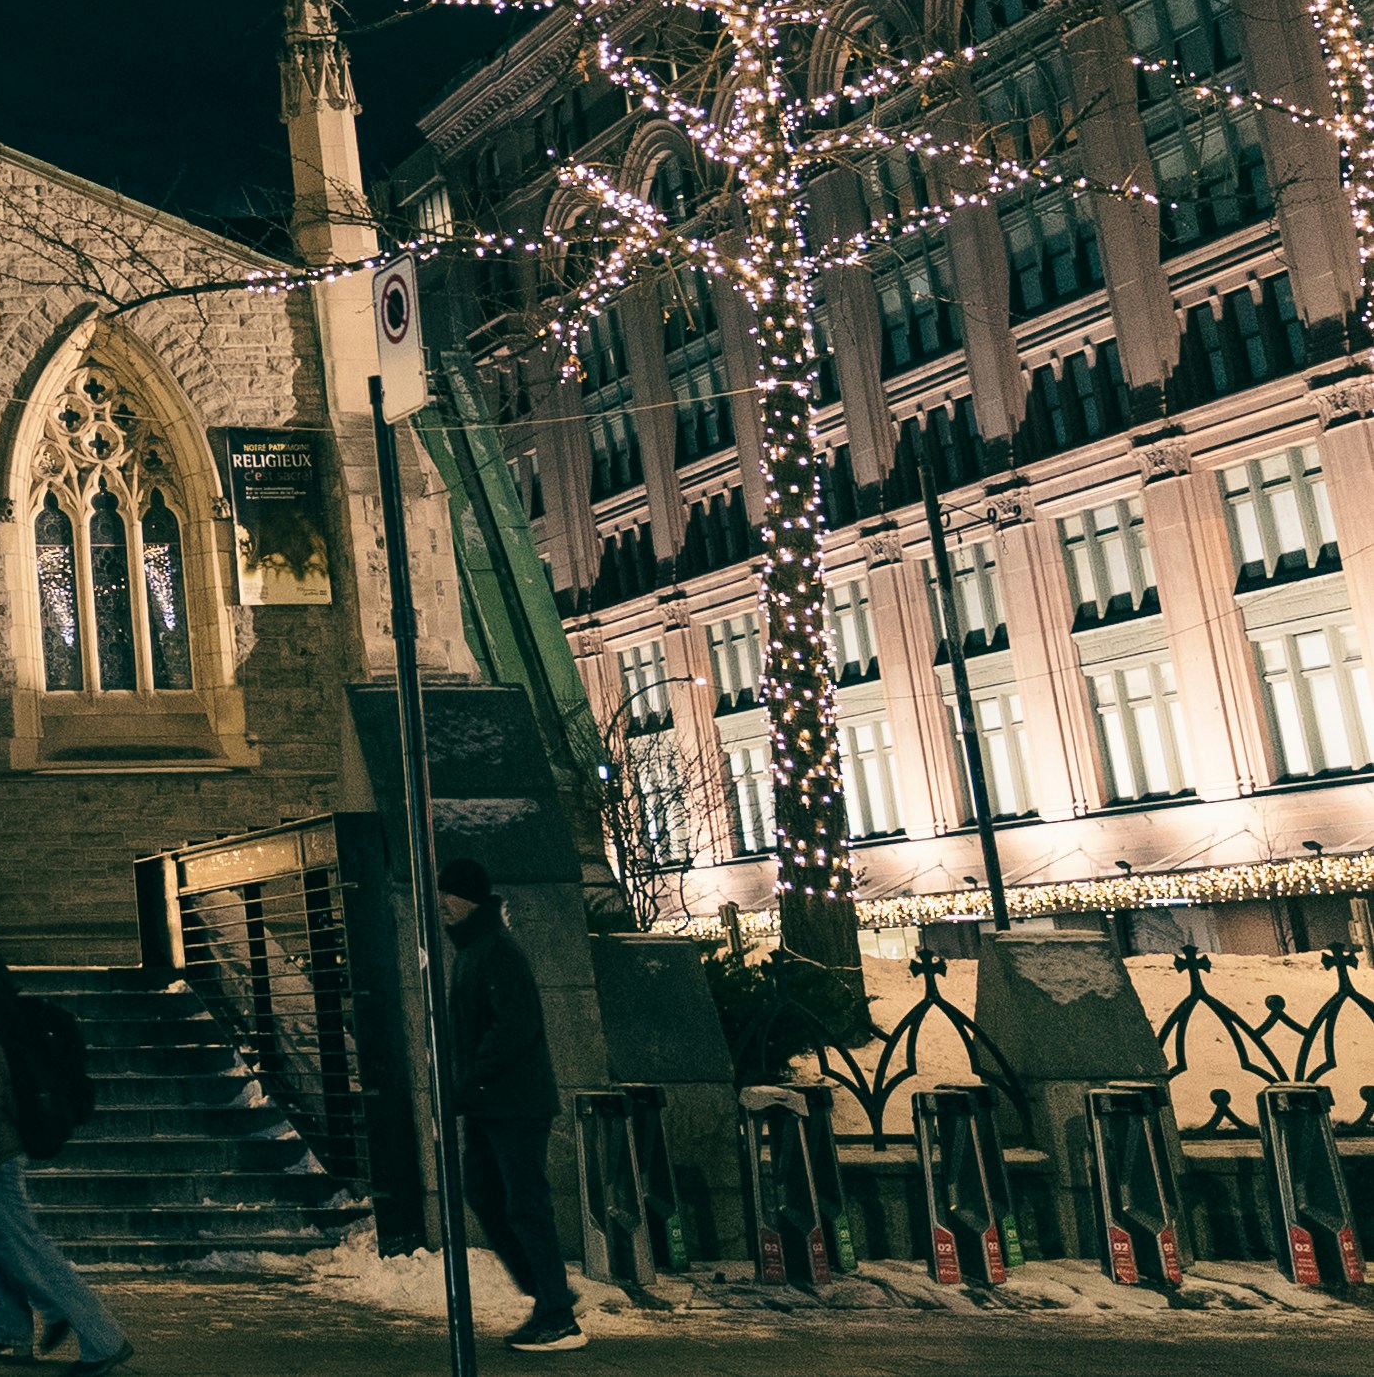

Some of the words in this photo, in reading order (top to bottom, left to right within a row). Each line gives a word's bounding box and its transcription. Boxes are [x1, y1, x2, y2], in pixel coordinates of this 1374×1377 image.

[243, 443, 266, 452] NOTRE
[268, 443, 310, 452] PATRIMOINE
[232, 453, 312, 468] RELIGIEUX
[764, 1243, 779, 1252] 02
[937, 1243, 952, 1252] 02
[988, 1242, 999, 1251] 02
[1113, 1243, 1129, 1252] 02
[1295, 1244, 1311, 1253] 02
